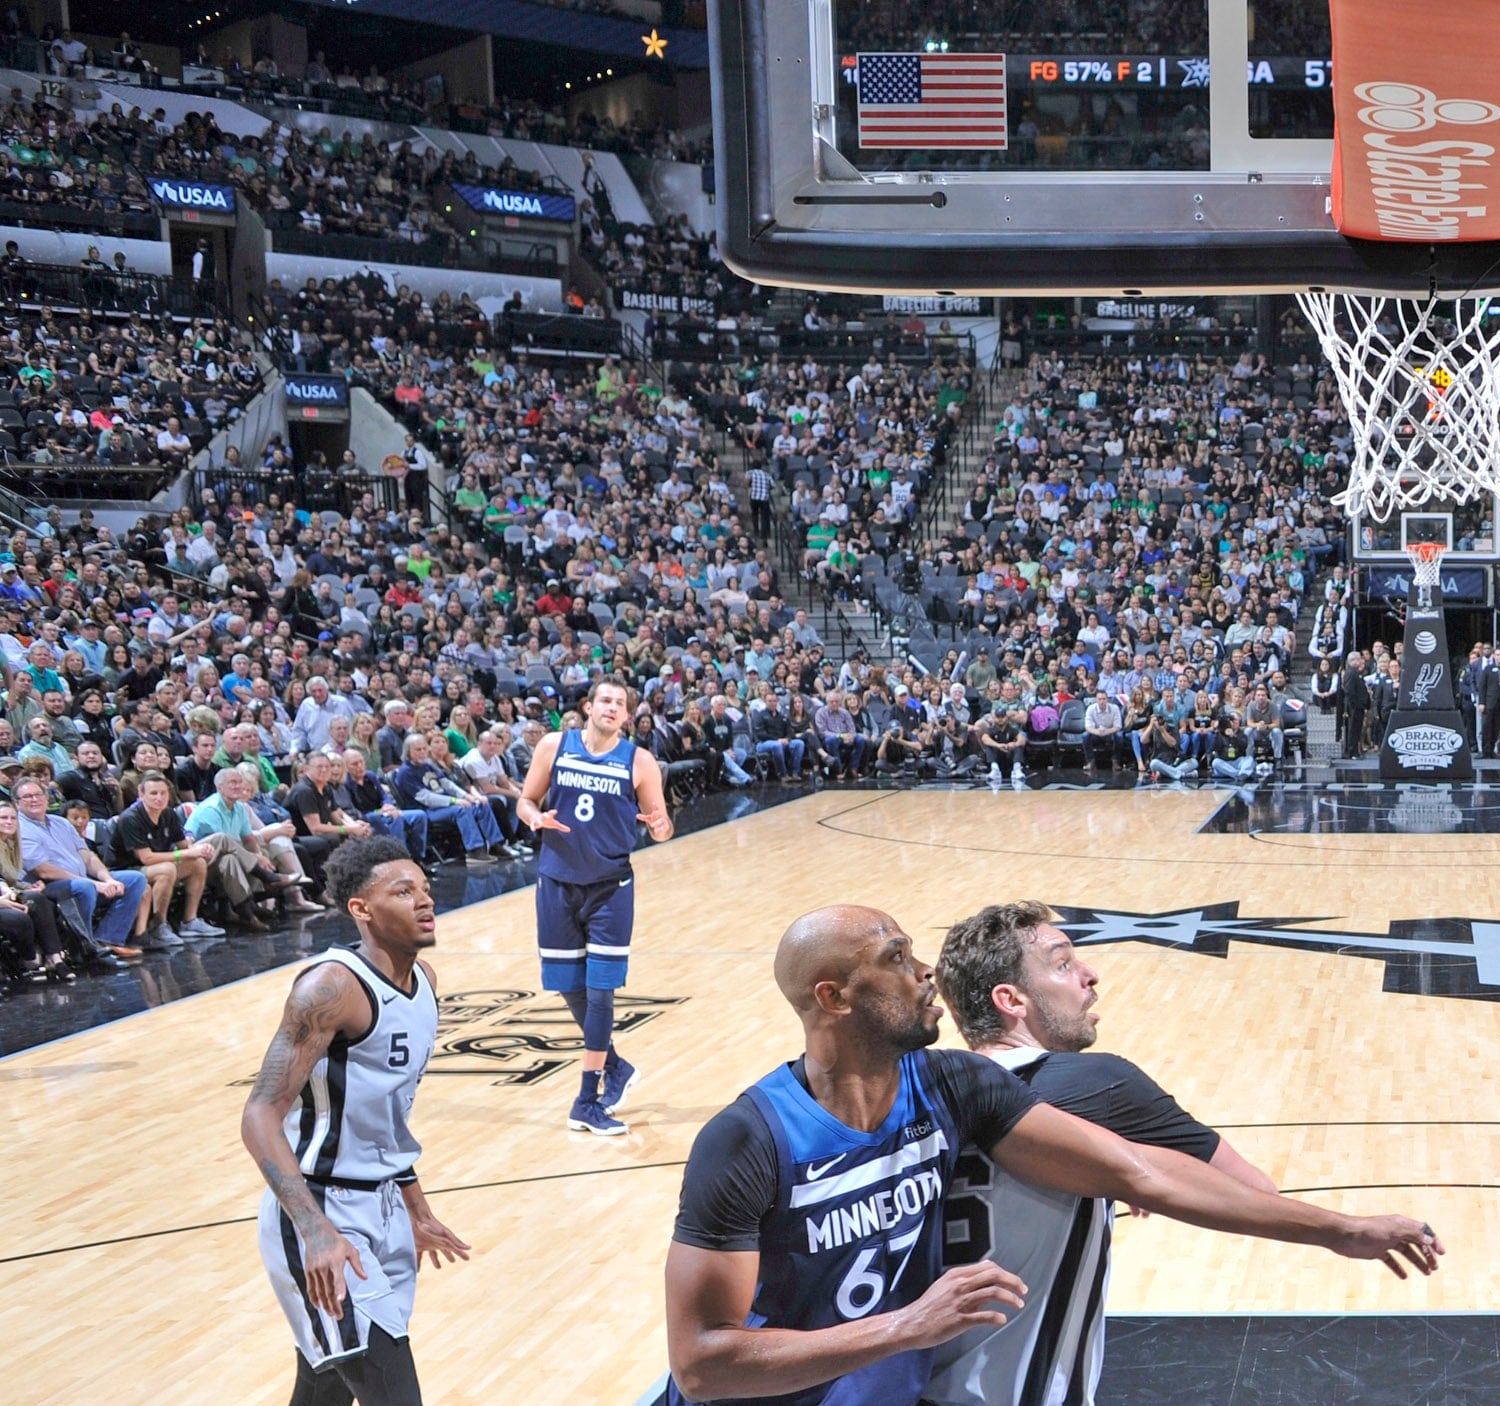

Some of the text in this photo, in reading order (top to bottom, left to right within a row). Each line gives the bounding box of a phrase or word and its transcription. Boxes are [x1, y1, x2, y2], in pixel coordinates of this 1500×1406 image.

[1030, 61, 1152, 82] FG 57% F 2
[178, 186, 227, 208] USAA
[502, 194, 543, 215] USAA
[301, 384, 337, 399] USAA
[1405, 731, 1446, 740] BRAKE
[1405, 742, 1445, 750] CHECK
[556, 770, 621, 796] MINNESOTA
[574, 793, 594, 822] 8
[388, 1031, 410, 1068] 5
[904, 1121, 932, 1140] fitbit
[806, 1166, 942, 1254] MINNESOTA
[835, 1215, 926, 1319] 67
